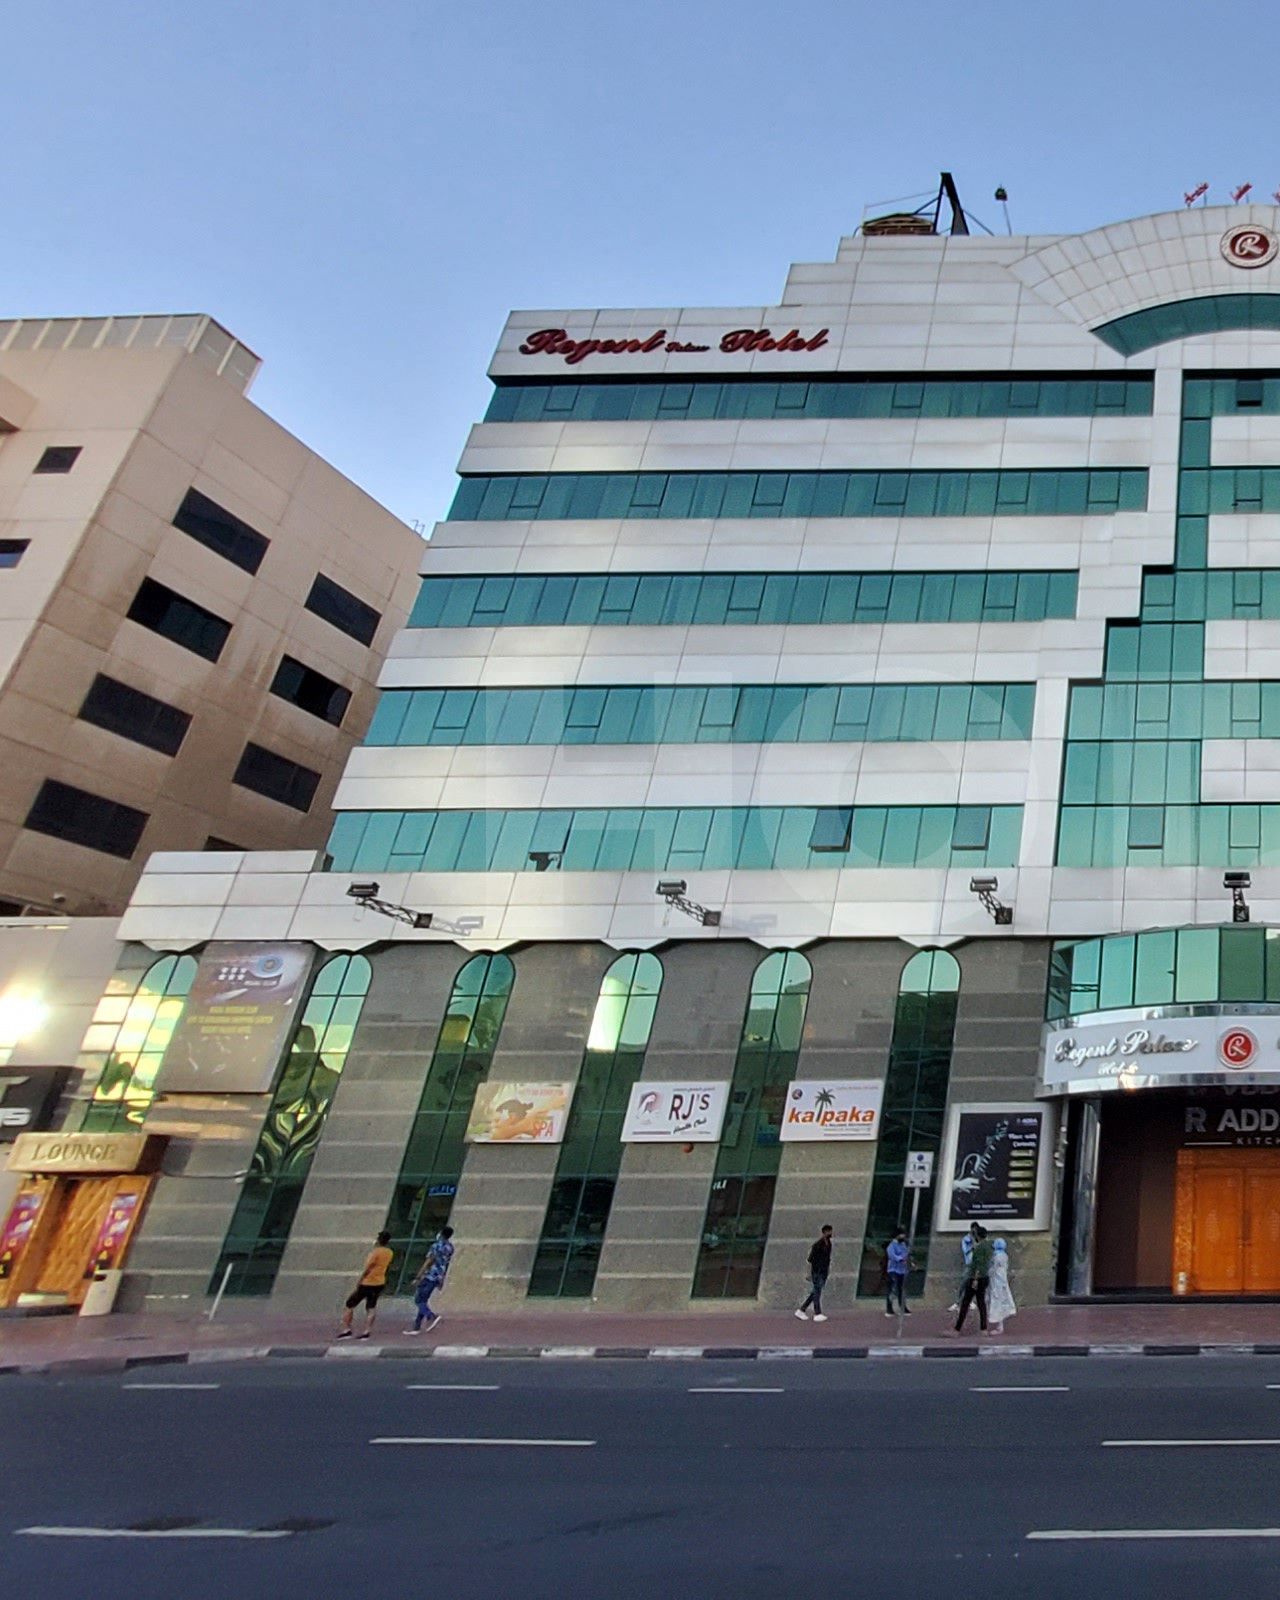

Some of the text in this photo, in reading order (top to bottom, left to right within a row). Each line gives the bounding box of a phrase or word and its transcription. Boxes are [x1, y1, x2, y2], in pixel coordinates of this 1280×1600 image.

[519, 329, 667, 364] Regent
[719, 329, 829, 353] Hotel
[1054, 1038, 1119, 1067] Regent
[31, 1143, 117, 1161] LOUNGE
